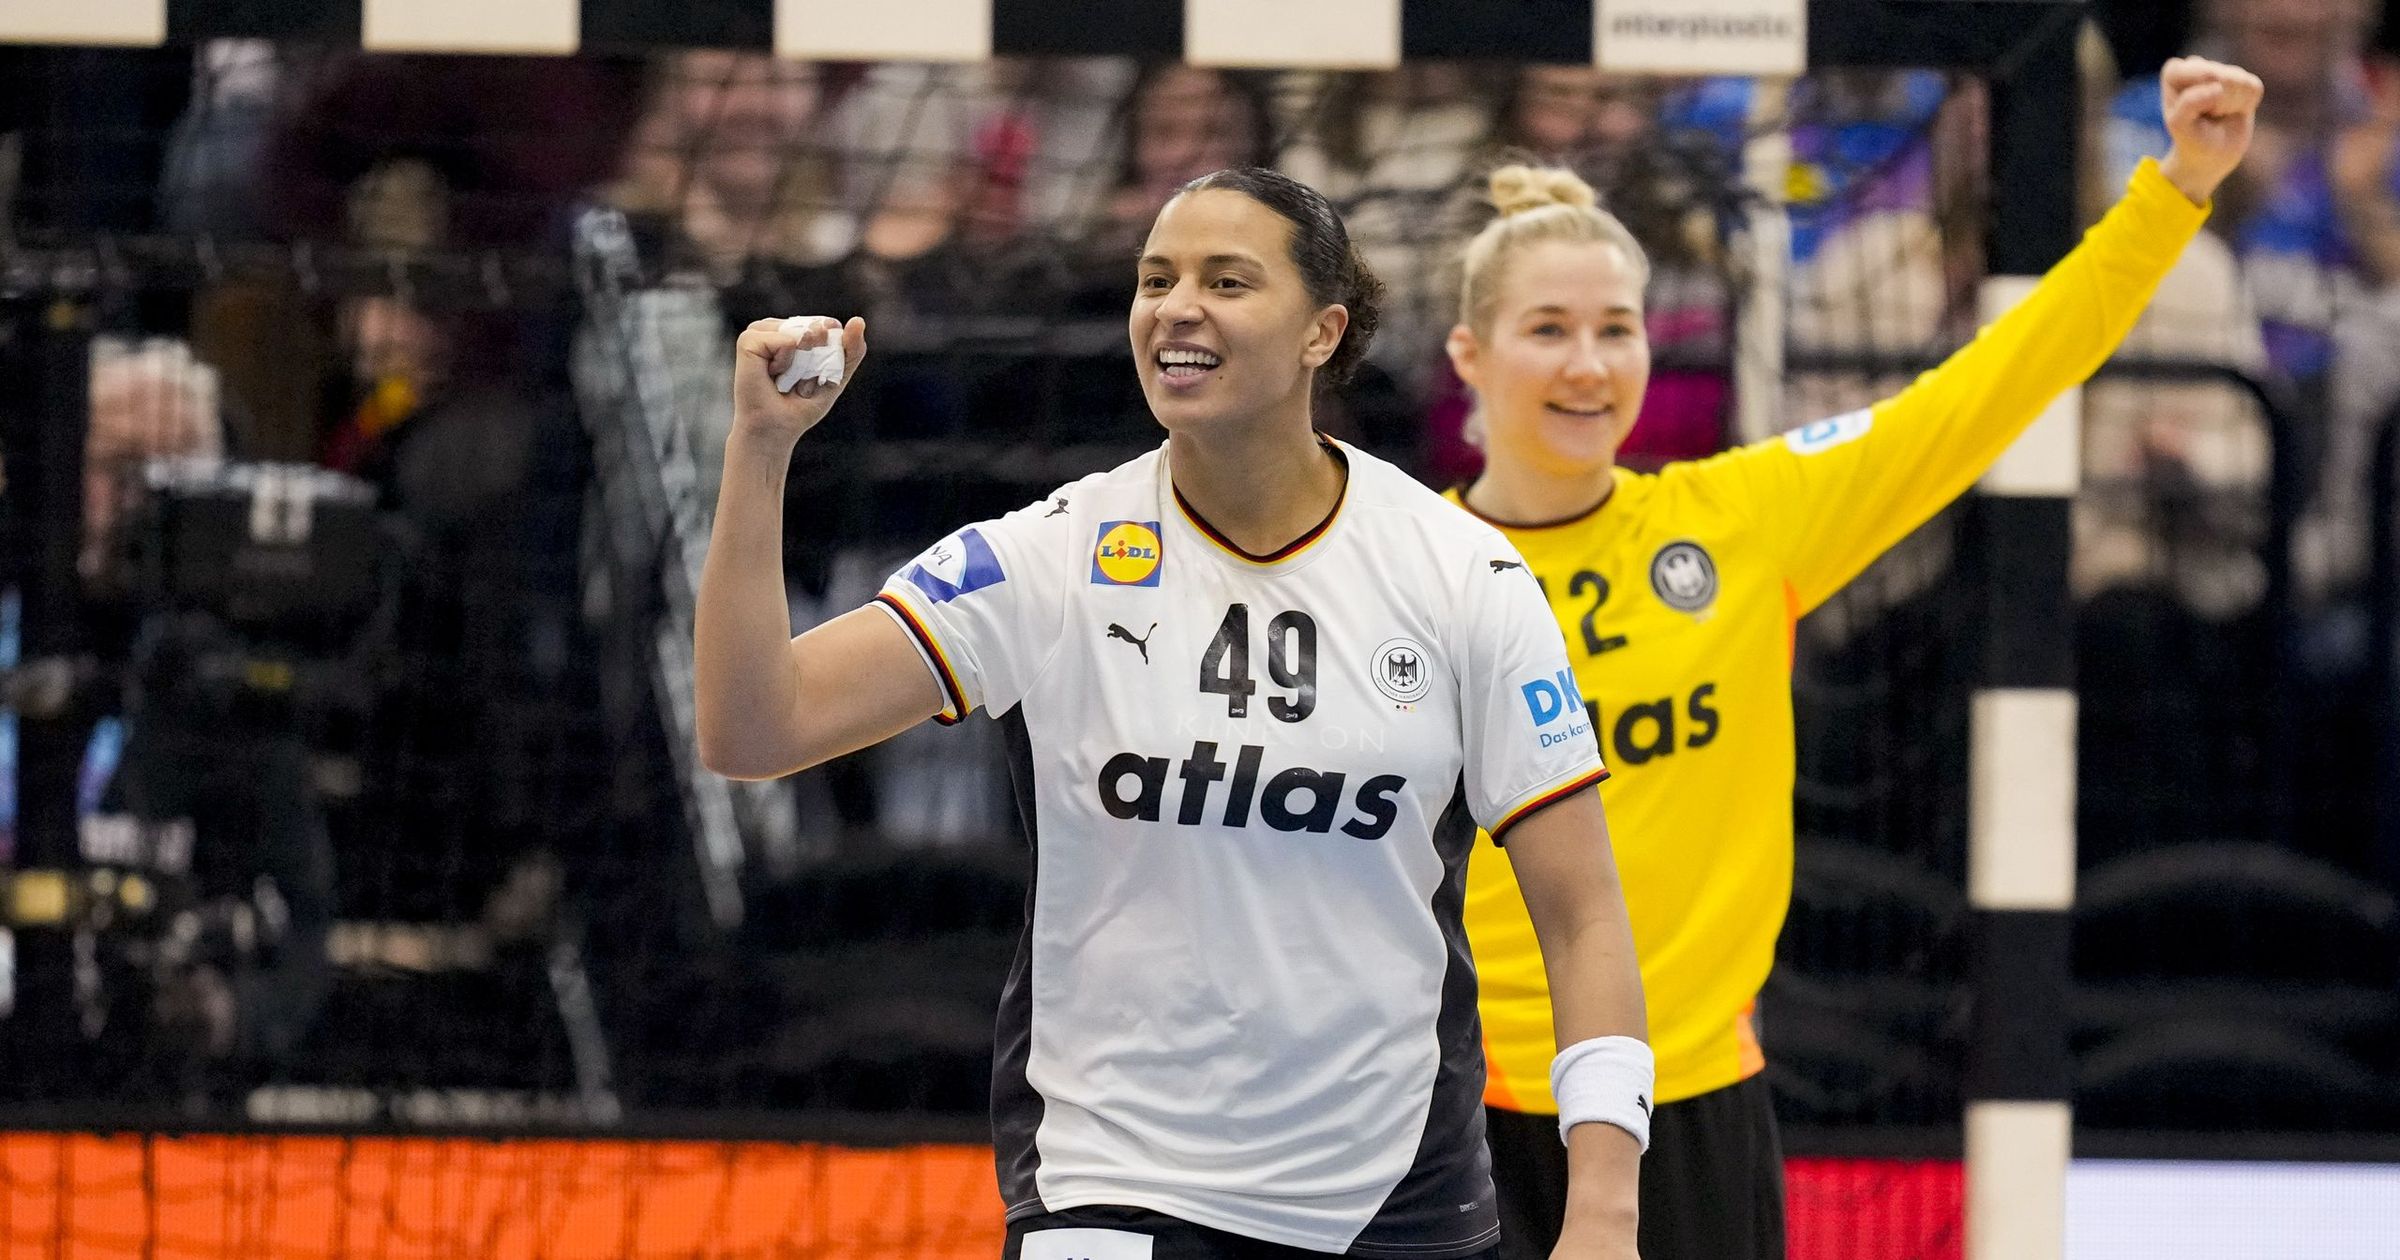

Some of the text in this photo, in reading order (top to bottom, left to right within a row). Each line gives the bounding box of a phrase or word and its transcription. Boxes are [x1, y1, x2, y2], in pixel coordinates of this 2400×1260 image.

[1199, 602, 1318, 724] 49
[1540, 731, 1568, 748] Das
[1097, 740, 1408, 841] atlas
